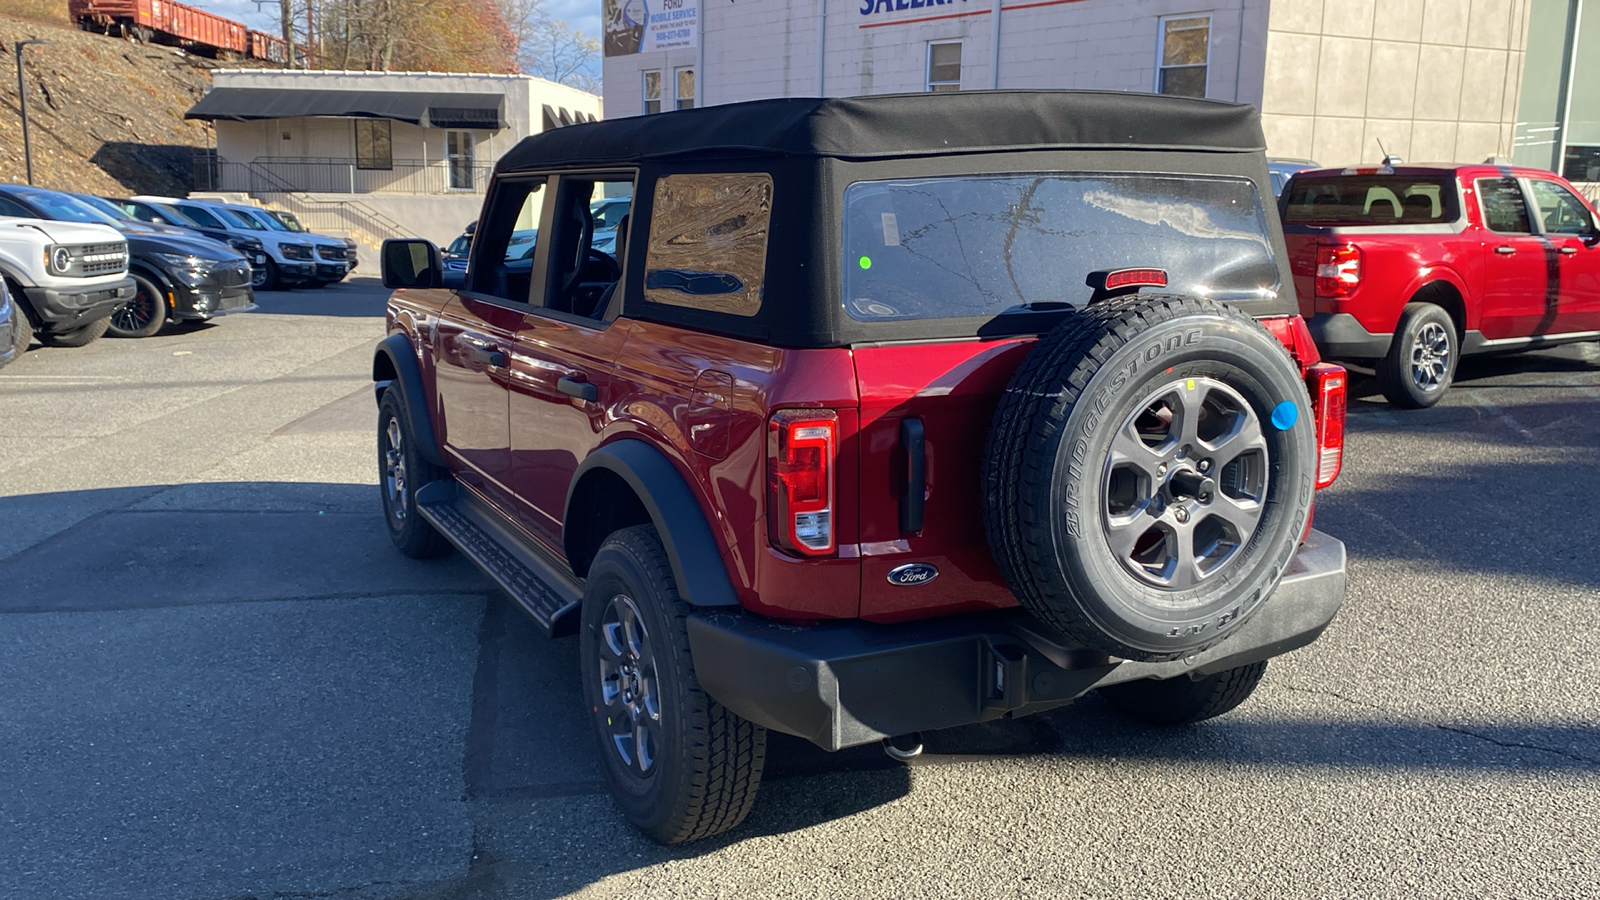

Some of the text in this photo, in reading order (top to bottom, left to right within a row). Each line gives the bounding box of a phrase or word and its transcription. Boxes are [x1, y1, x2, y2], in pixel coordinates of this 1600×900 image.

[663, 0, 682, 10] FORD
[650, 7, 696, 23] MOBILE SERVICE
[1063, 328, 1203, 538] BRIDGESTONE
[1215, 472, 1311, 629] DUELER
[899, 567, 929, 583] Ford
